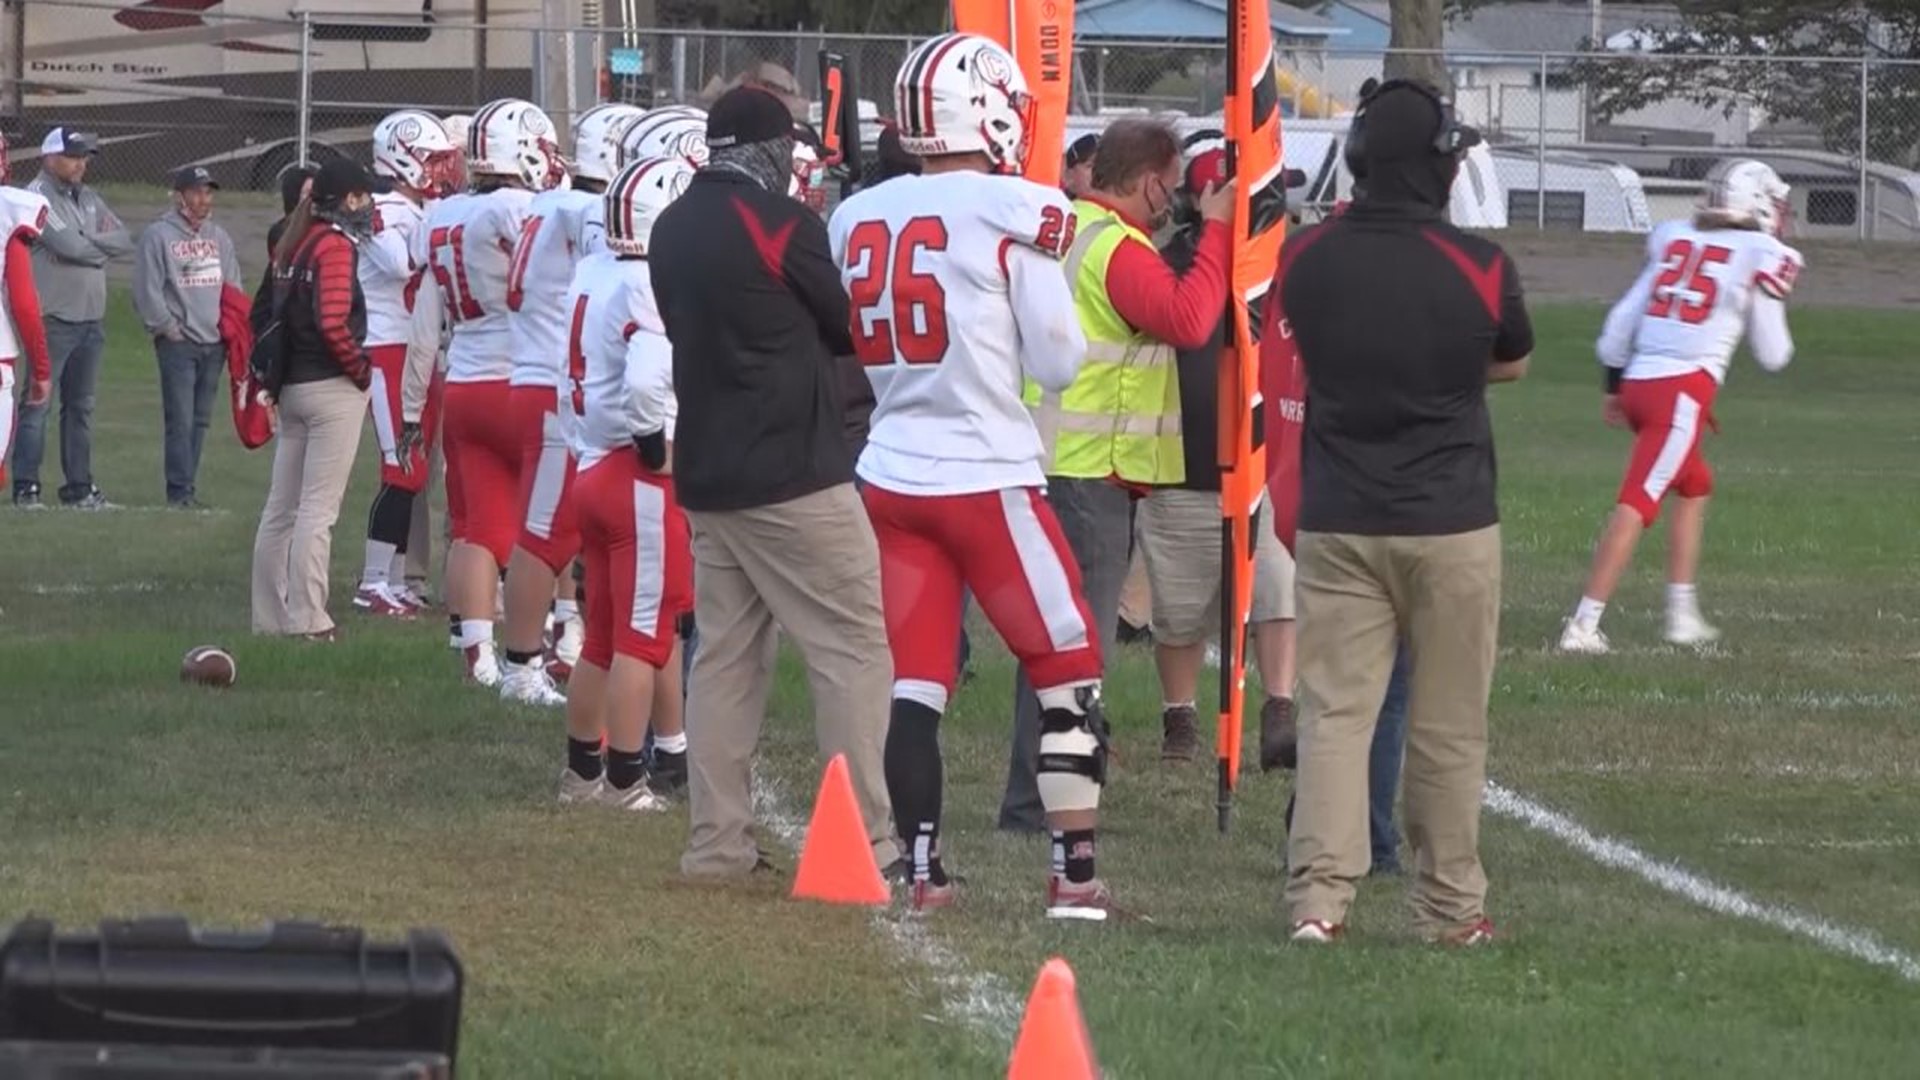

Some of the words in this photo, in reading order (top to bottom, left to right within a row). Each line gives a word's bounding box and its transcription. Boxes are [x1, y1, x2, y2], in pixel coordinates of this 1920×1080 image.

[31, 61, 104, 73] Dutch
[113, 62, 168, 74] Star
[1040, 25, 1060, 82] DOWN
[846, 215, 950, 365] 26
[1644, 239, 1732, 325] 25
